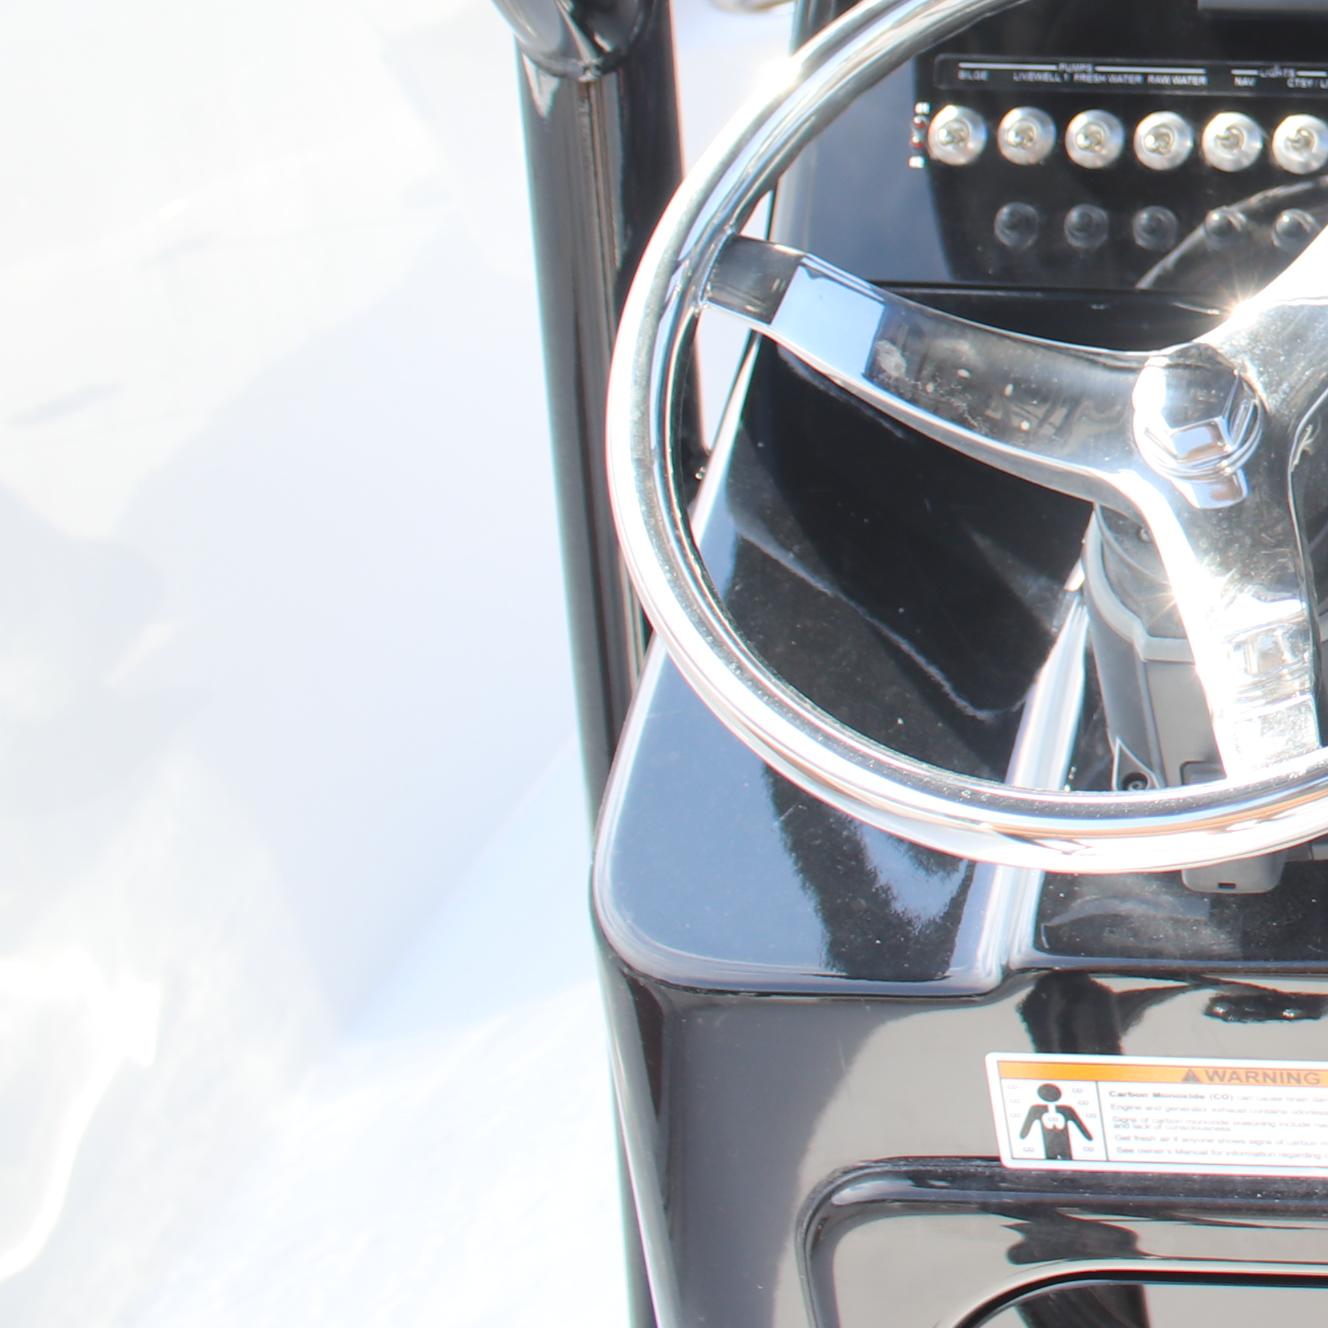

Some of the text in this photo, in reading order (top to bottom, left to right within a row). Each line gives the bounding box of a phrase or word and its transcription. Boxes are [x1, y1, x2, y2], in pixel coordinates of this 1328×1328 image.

[1058, 63, 1093, 72] PUMPS
[958, 71, 988, 81] BILGE
[1013, 72, 1061, 83] LIVEWELL
[1073, 73, 1143, 84] FRESH WATER
[1148, 74, 1208, 86] RAW WATER
[1234, 77, 1255, 87] NAV
[1204, 1068, 1322, 1087] WARNING
